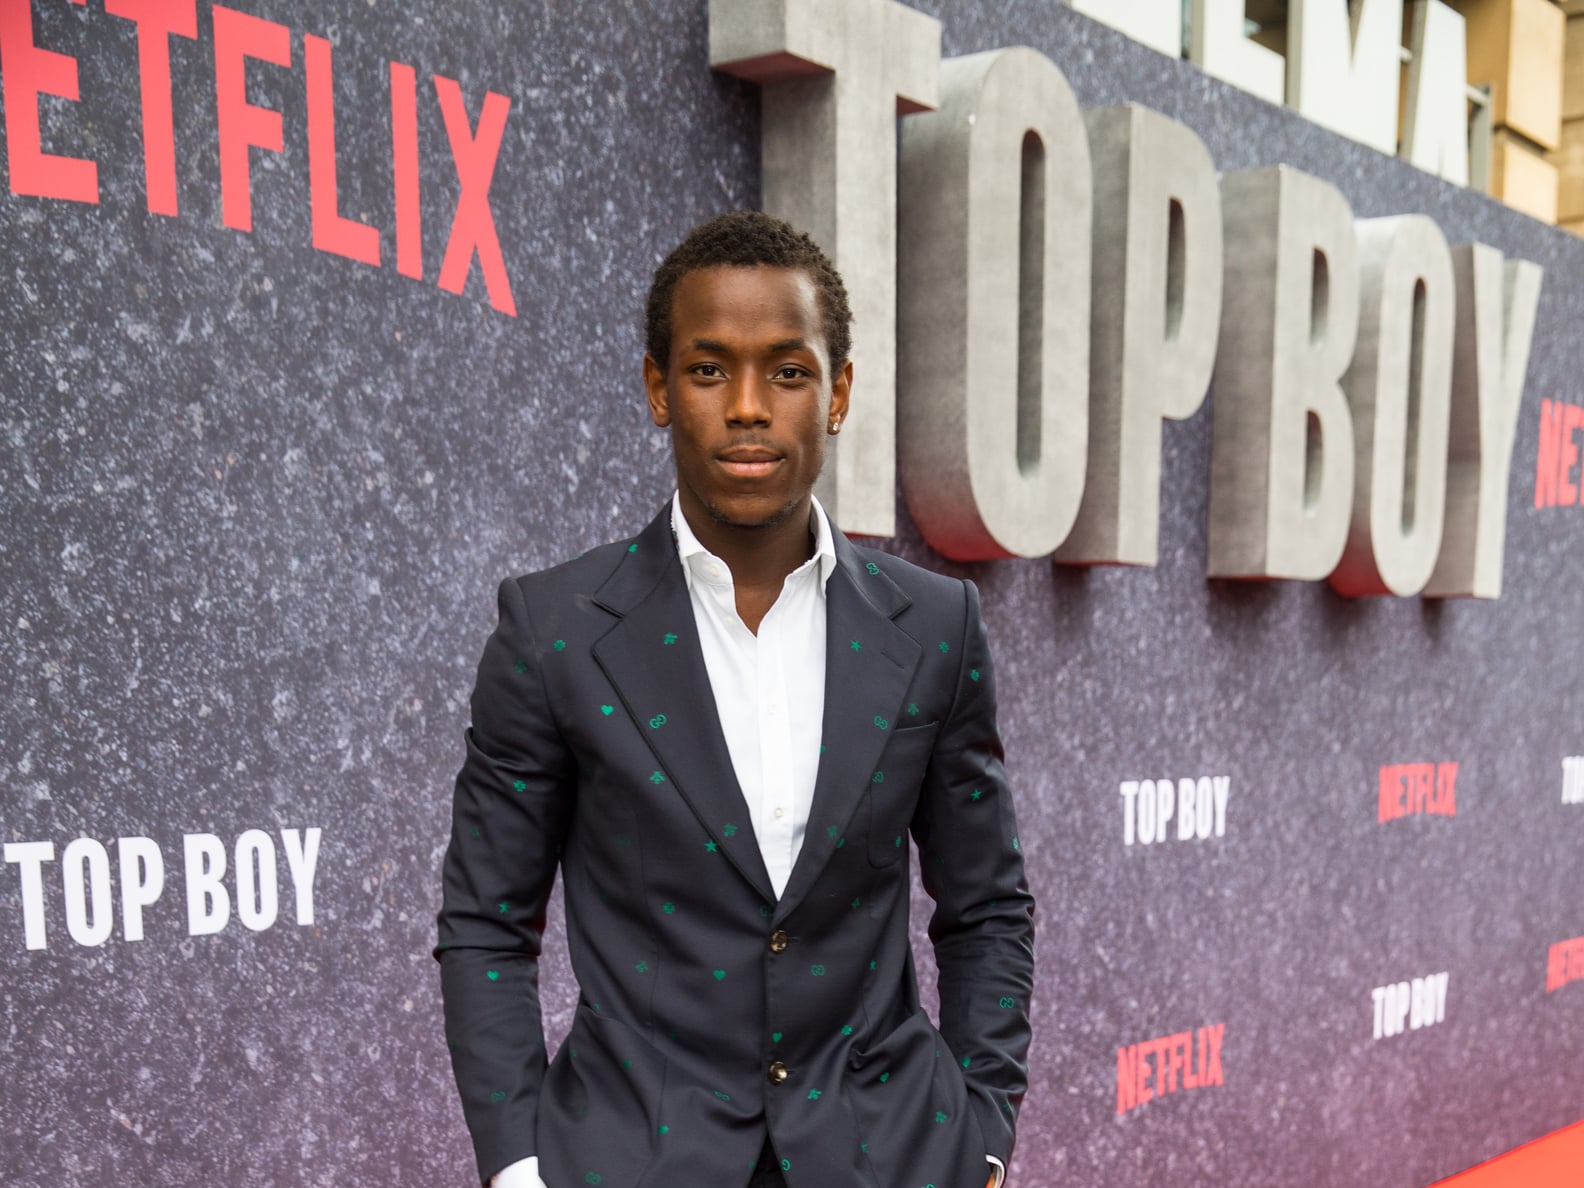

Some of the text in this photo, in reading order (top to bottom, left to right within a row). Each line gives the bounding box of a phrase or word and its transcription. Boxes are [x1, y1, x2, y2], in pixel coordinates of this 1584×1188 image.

[709, 0, 1544, 600] TOP BOY
[1535, 397, 1584, 510] NE
[1120, 775, 1230, 846] TOP BOY
[1378, 761, 1458, 824] NETFLIX
[3, 827, 322, 950] TOP BOY
[1372, 980, 1411, 1040] TOP
[1116, 1023, 1225, 1115] NETFLIX
